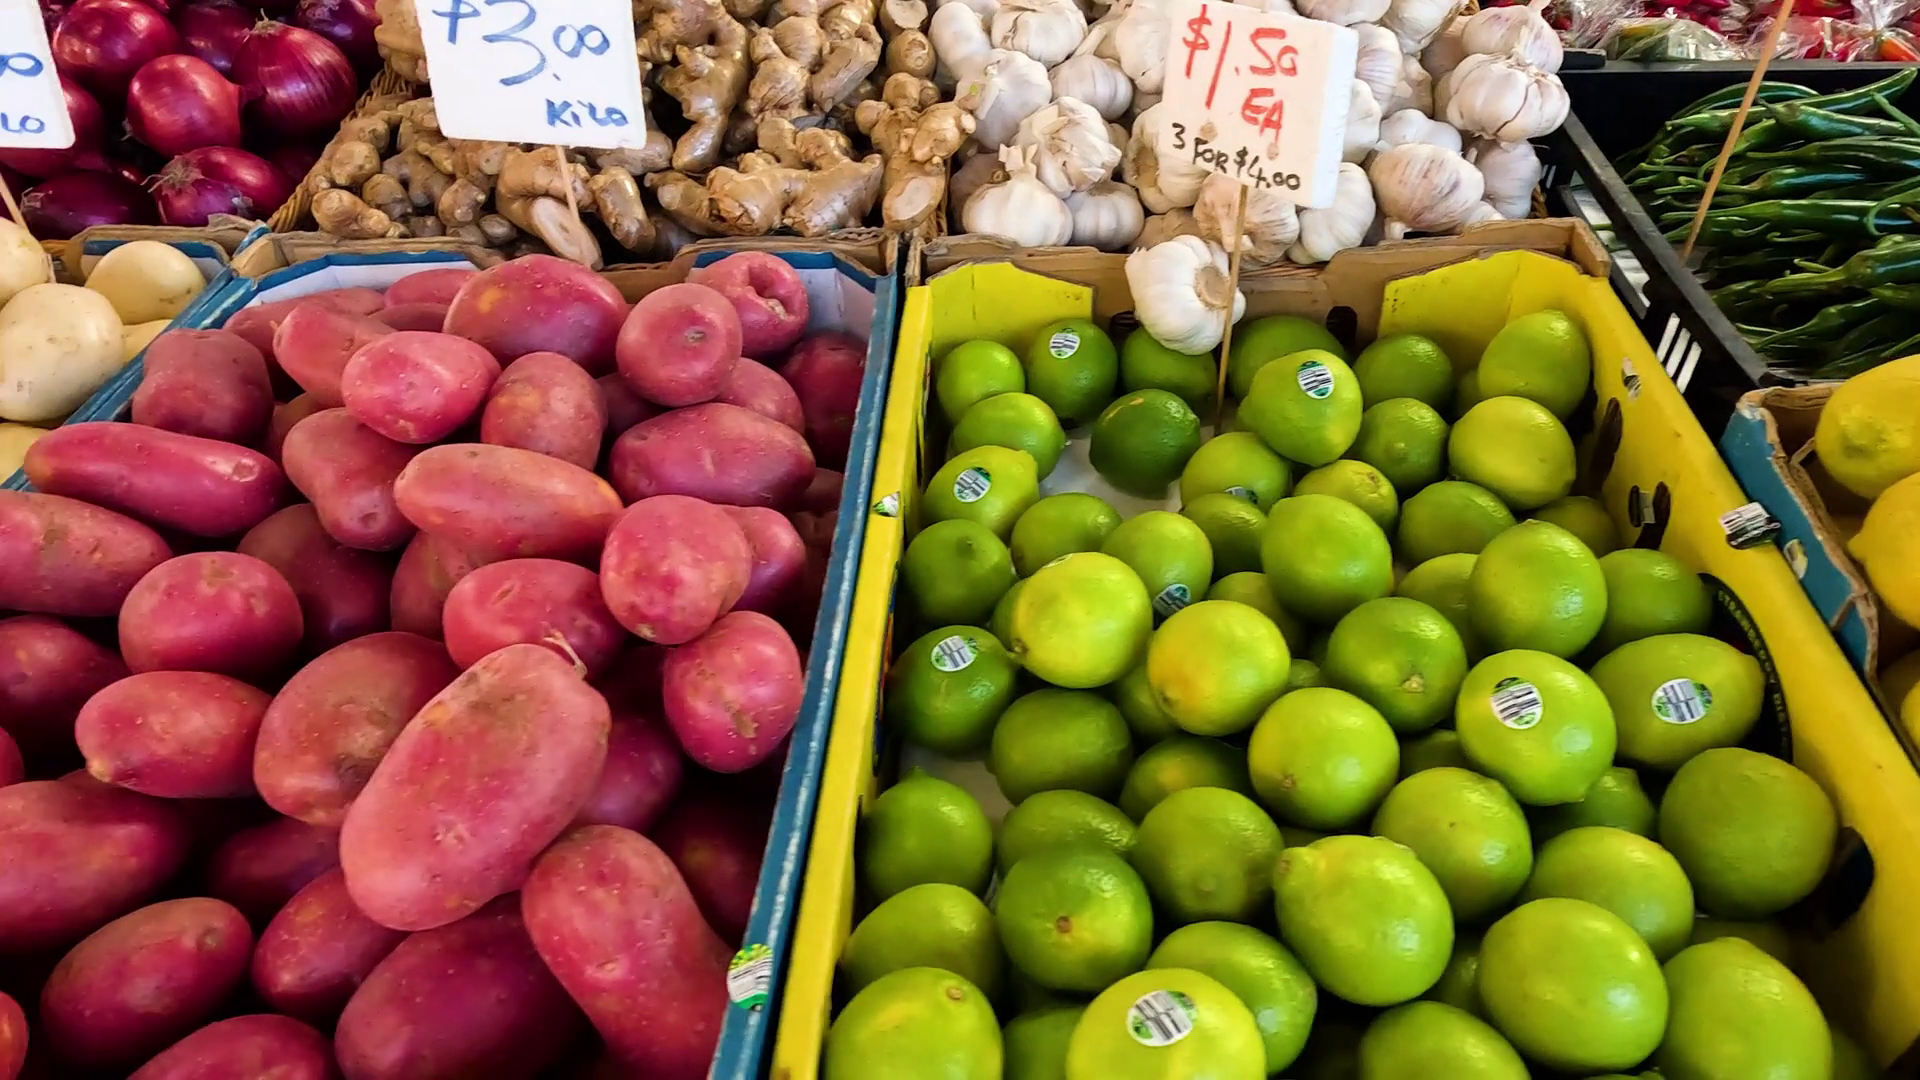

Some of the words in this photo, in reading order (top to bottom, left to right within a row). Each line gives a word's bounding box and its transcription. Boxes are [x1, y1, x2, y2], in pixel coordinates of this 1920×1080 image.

[0, 52, 43, 77] 0
[1183, 4, 1298, 109] $1.50
[1241, 88, 1283, 144] EA
[1172, 123, 1185, 149] 3
[1233, 146, 1300, 190] $4.00
